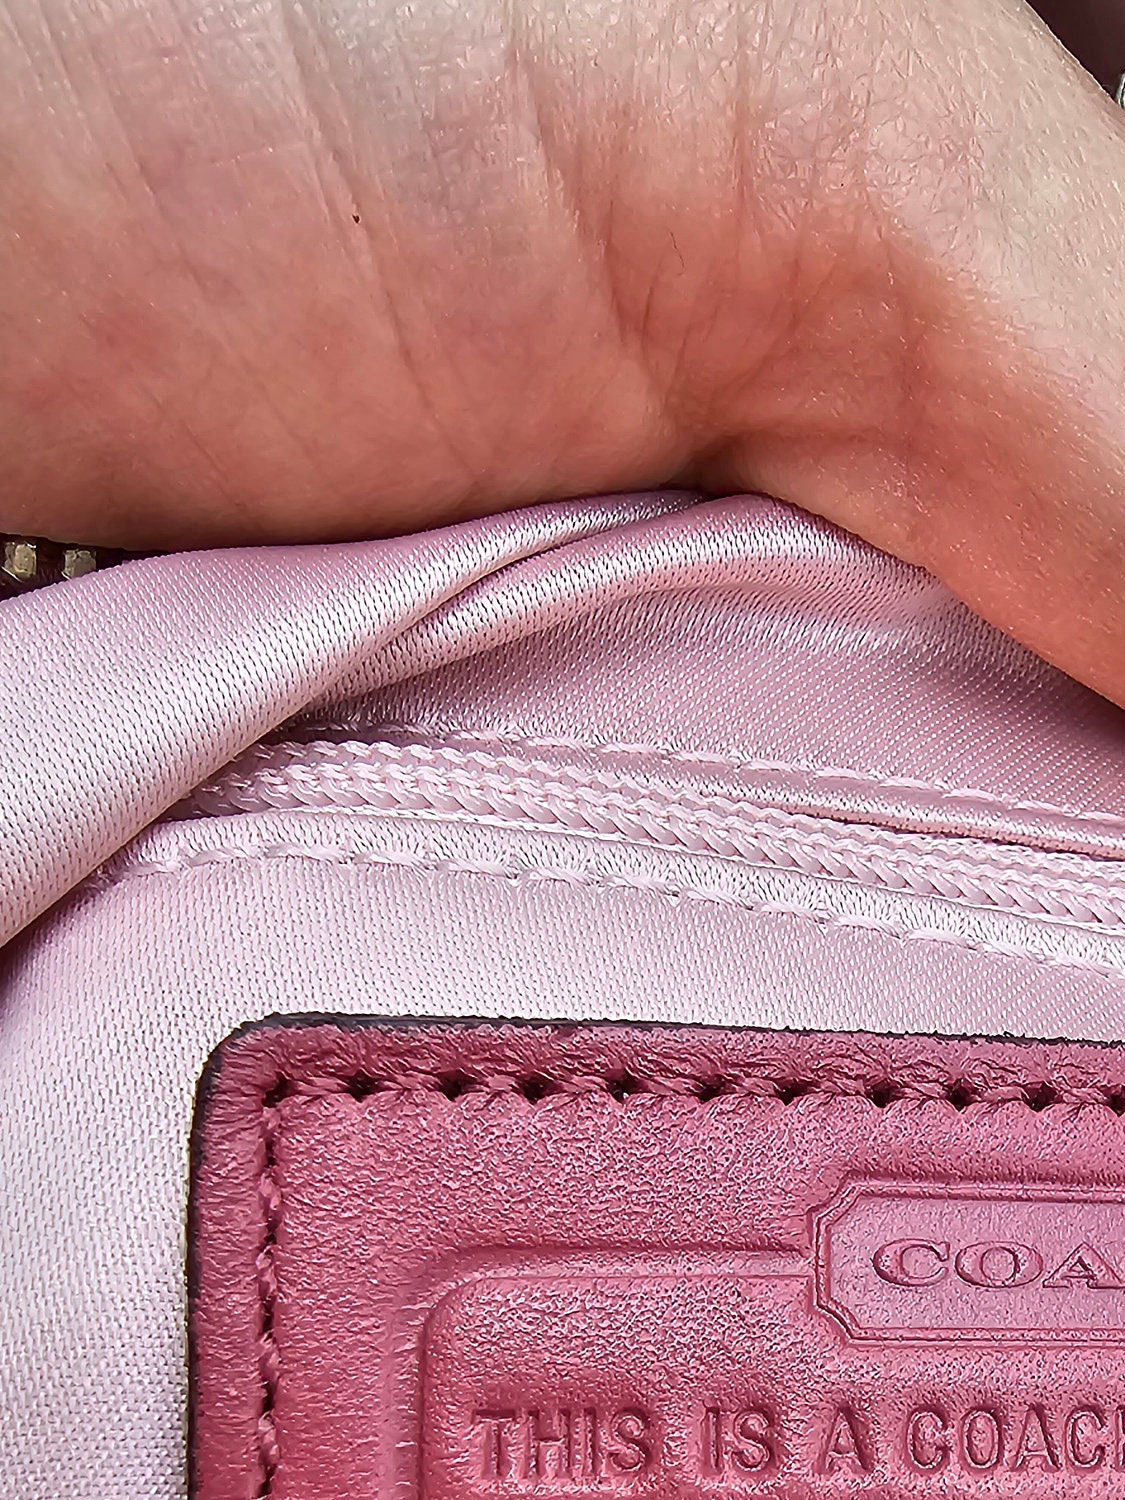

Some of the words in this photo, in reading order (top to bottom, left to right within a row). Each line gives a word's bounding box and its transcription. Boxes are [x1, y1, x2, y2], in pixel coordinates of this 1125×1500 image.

[472, 1408, 655, 1477] THIS
[702, 1406, 778, 1473] IS
[812, 1406, 872, 1473] A
